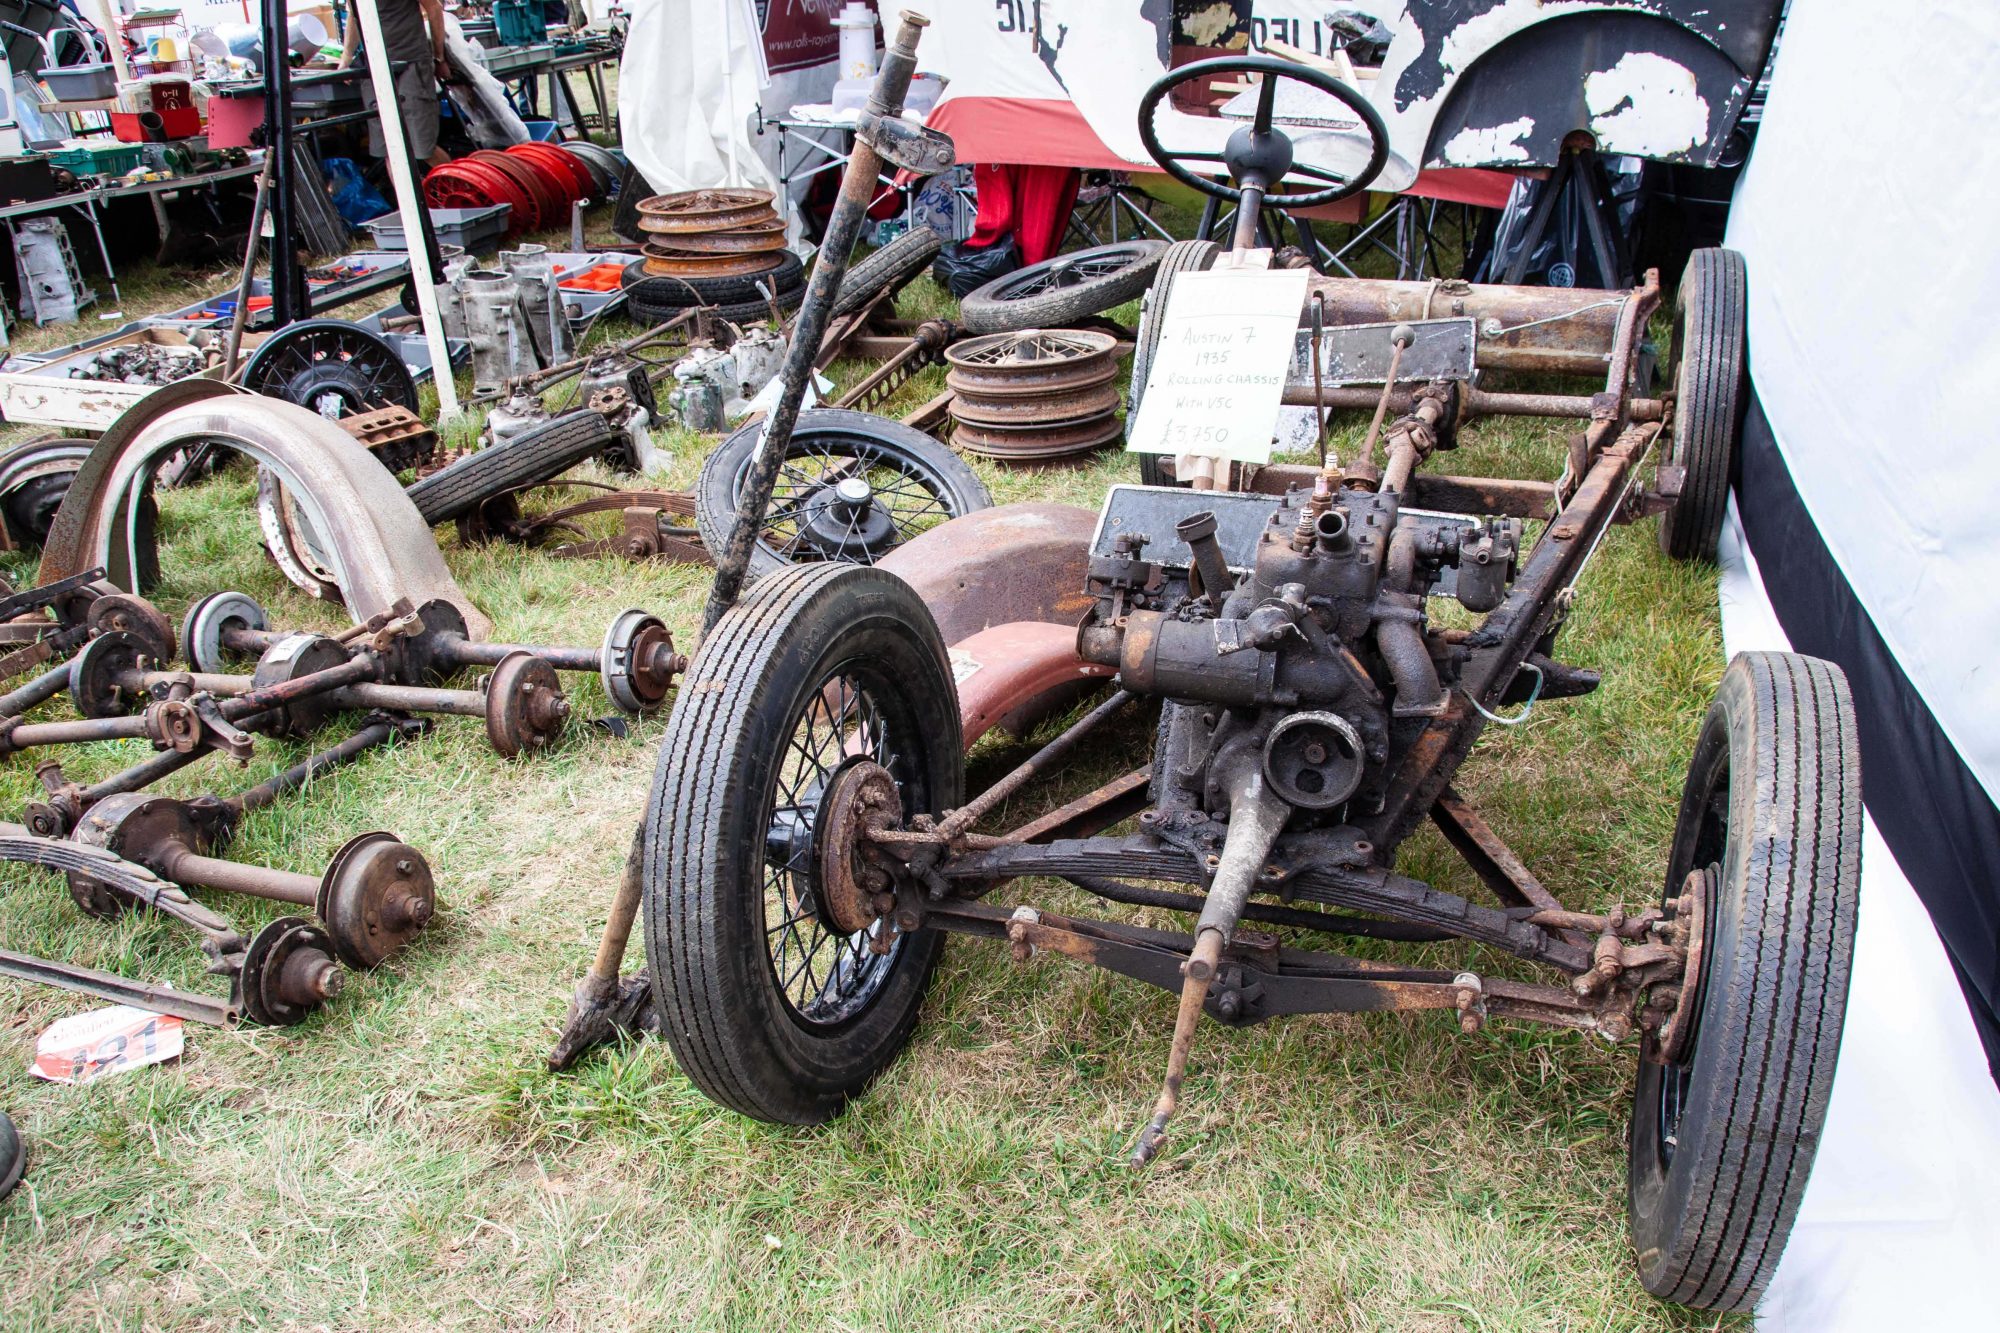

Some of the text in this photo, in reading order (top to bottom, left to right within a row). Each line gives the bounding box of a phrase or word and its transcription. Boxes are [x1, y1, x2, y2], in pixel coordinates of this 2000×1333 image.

[1182, 326, 1256, 345] AUSTIN 7
[1195, 350, 1231, 366] 1935
[1226, 374, 1280, 385] CHASSIS
[1207, 396, 1233, 409] V5C
